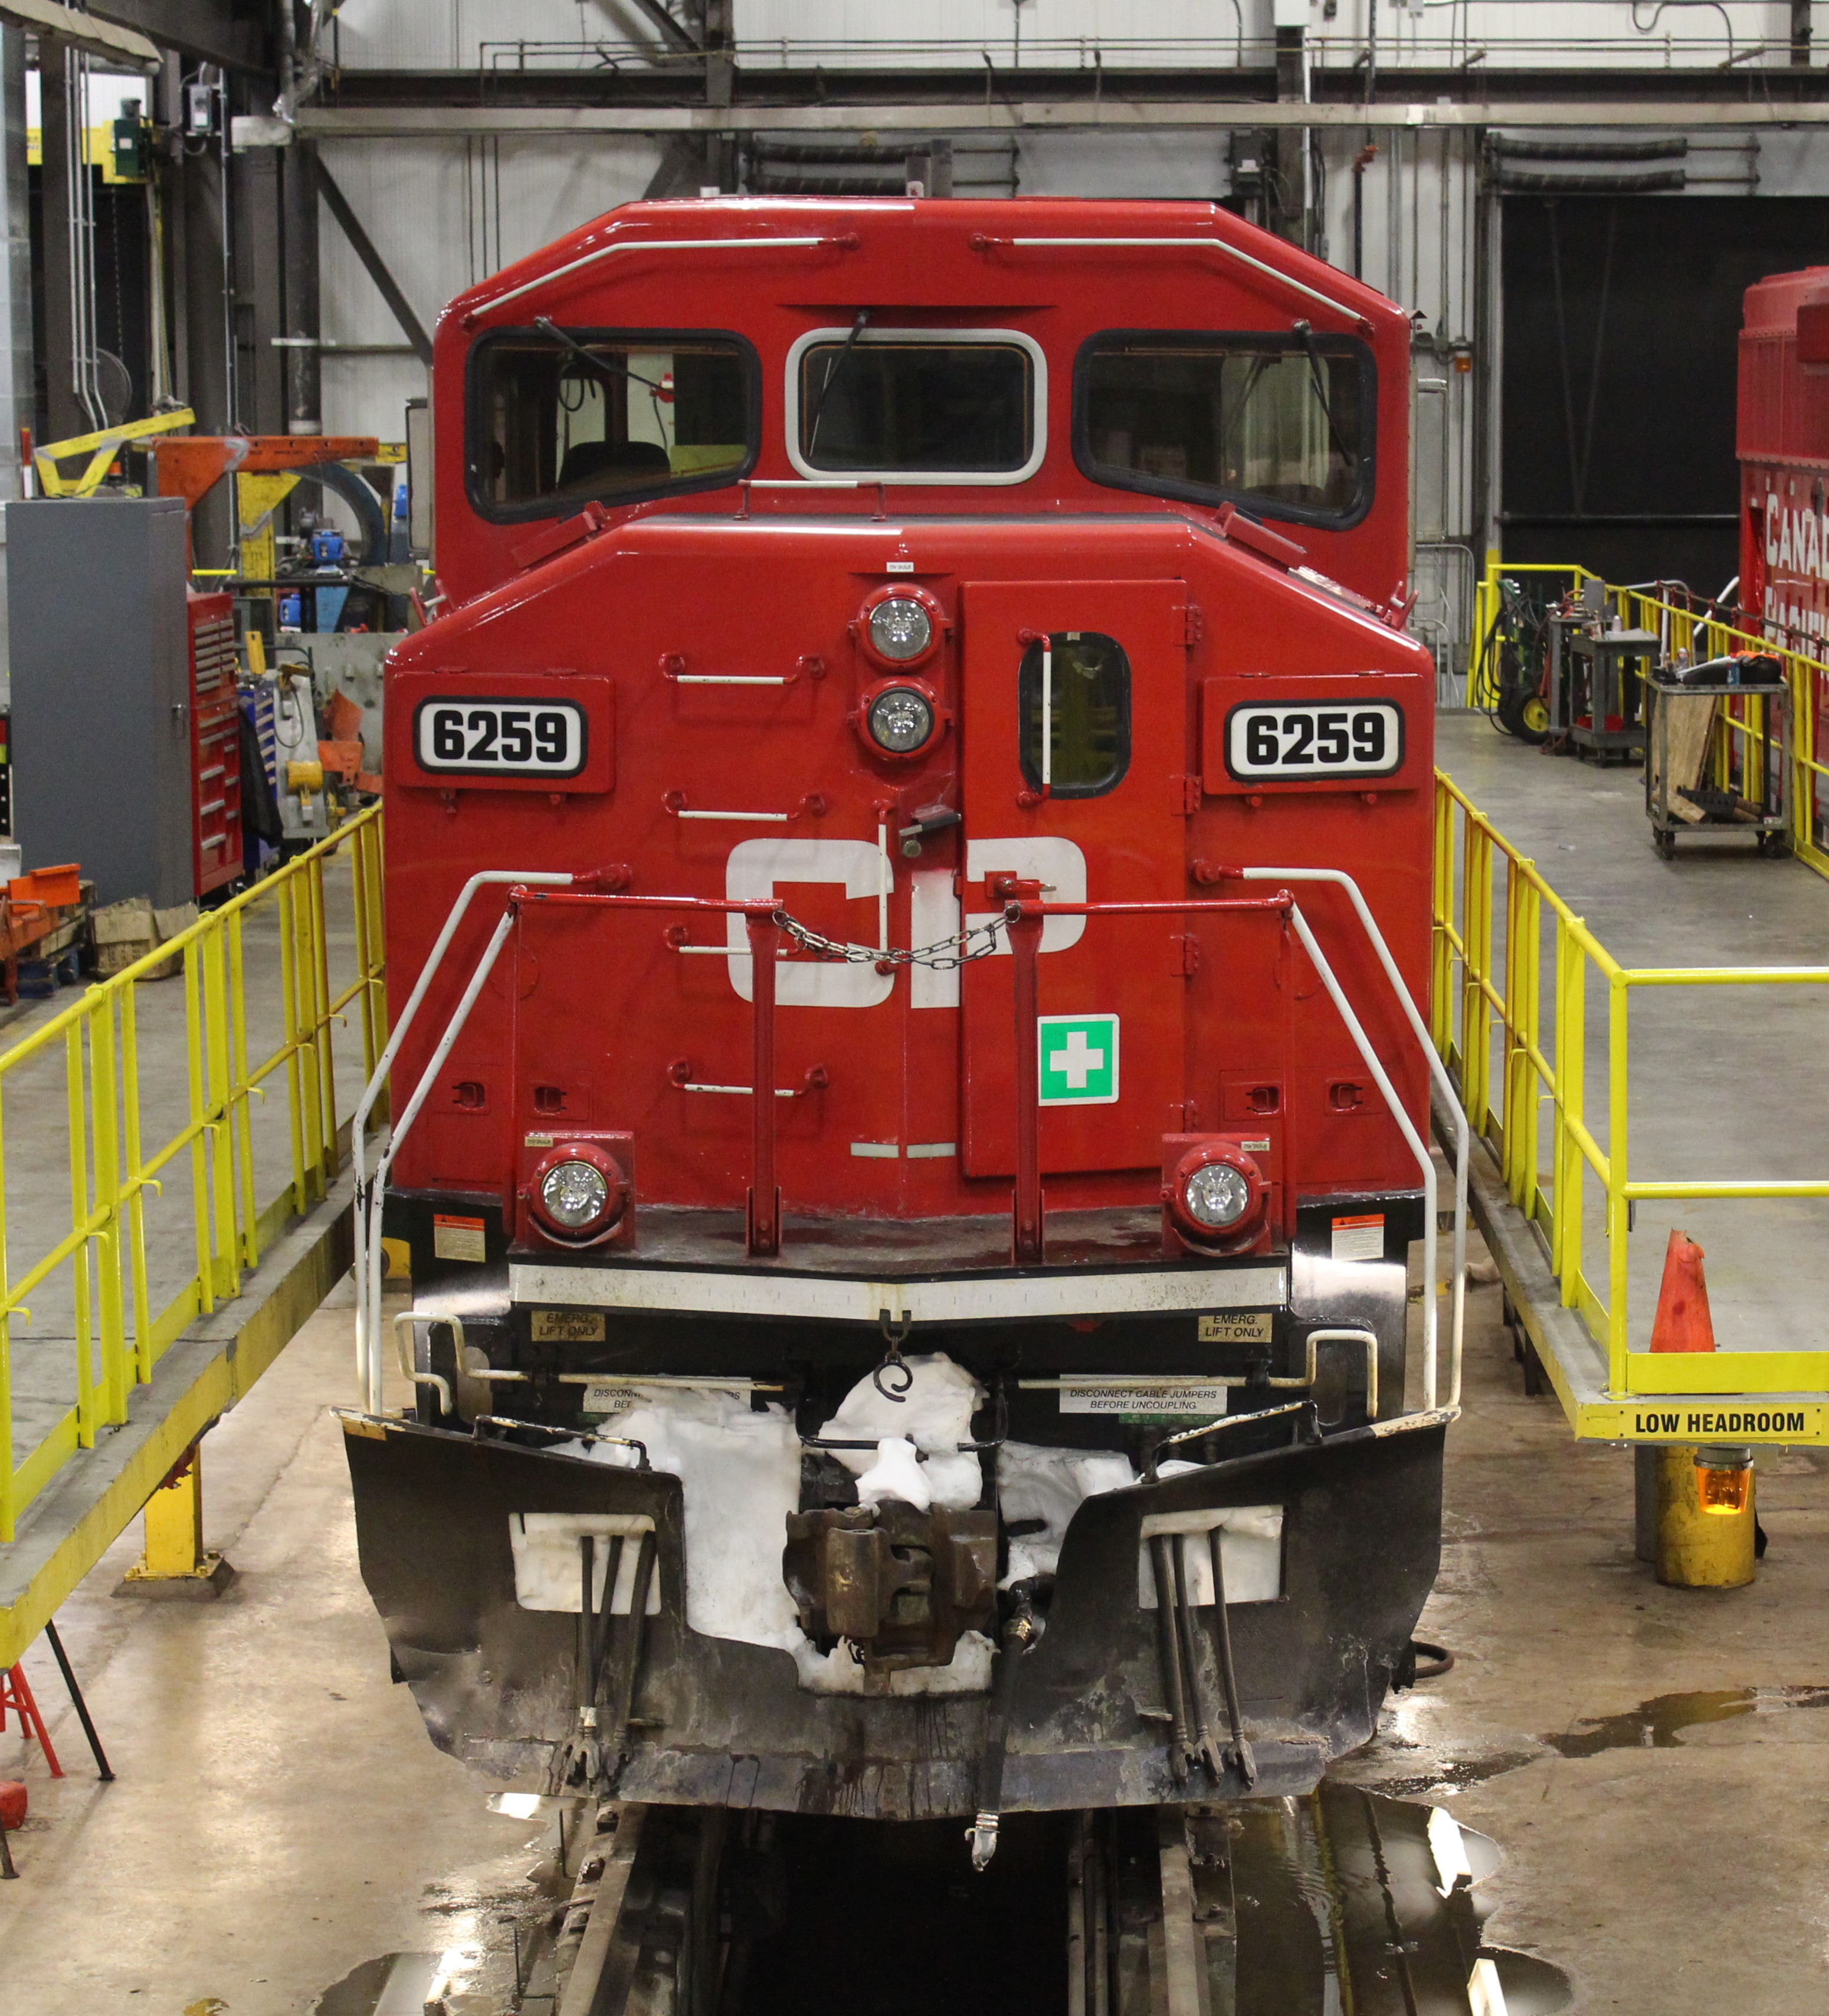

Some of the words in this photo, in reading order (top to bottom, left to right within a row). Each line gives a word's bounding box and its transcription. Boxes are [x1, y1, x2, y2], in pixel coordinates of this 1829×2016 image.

[433, 709, 567, 763] 6259
[1246, 712, 1385, 765] 6259
[726, 837, 1087, 1009] CP
[1214, 1315, 1257, 1325] EMERG.
[540, 1326, 565, 1336] LIFT
[567, 1326, 598, 1336] ONLY
[1205, 1327, 1231, 1336] LIFT
[1234, 1327, 1264, 1337] ONLY
[1070, 1389, 1133, 1398] DISCONNECT
[1136, 1390, 1168, 1398] CABLE
[1090, 1401, 1129, 1409] BEFORE
[1132, 1401, 1197, 1409] UNCOUPLING
[1635, 1414, 1680, 1432] LOW
[1687, 1412, 1804, 1432] HEADROOM
